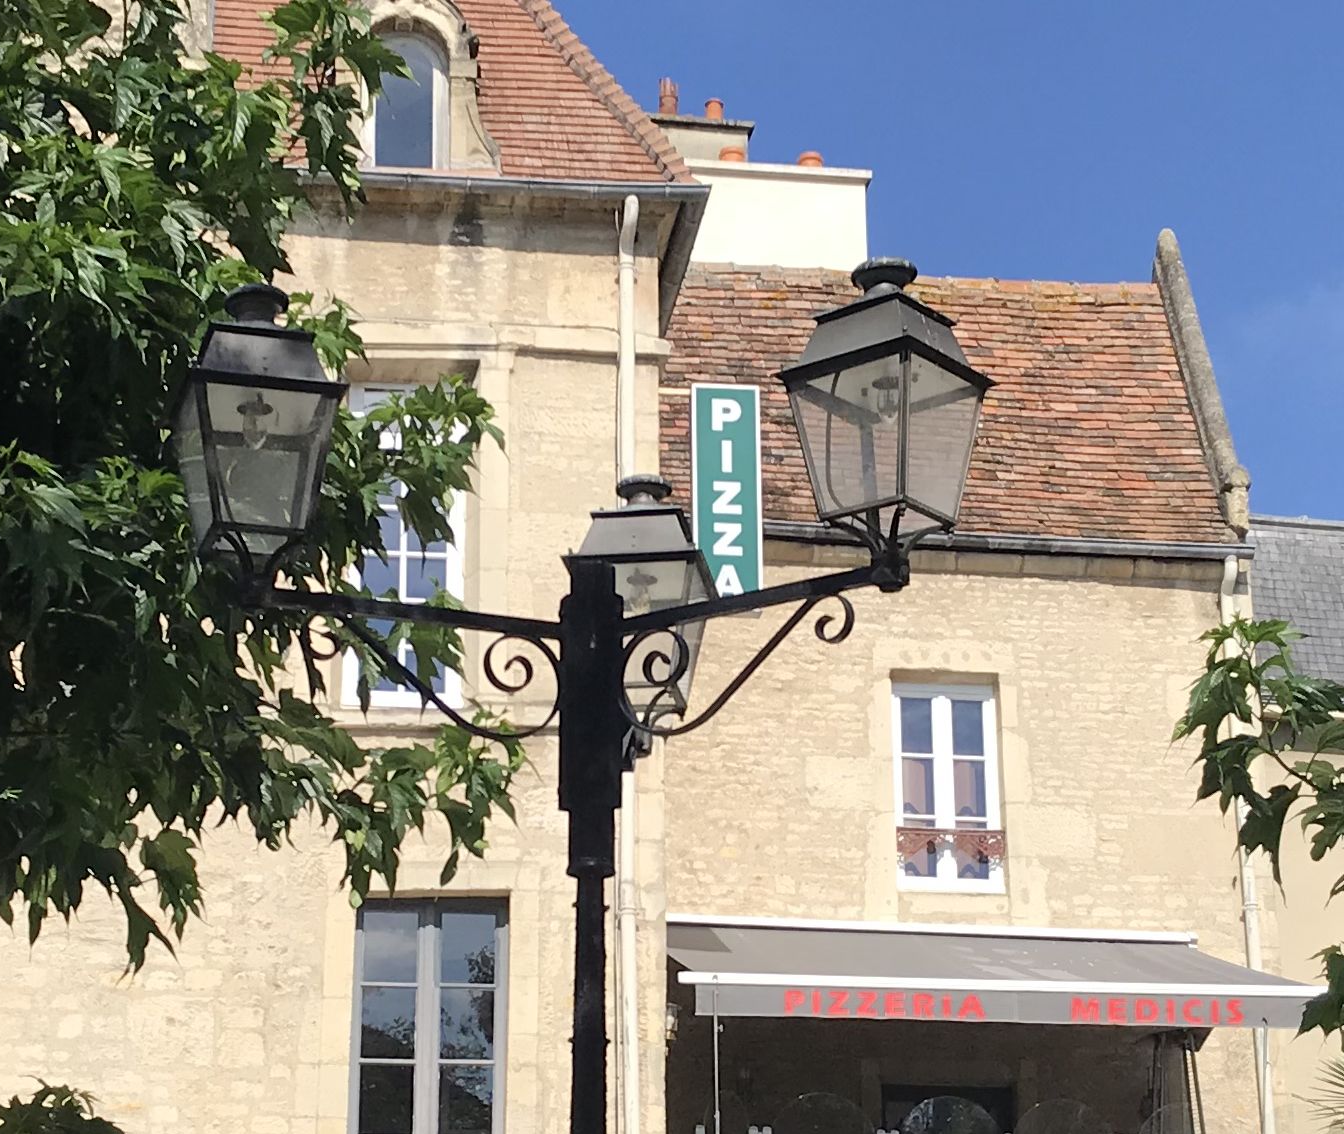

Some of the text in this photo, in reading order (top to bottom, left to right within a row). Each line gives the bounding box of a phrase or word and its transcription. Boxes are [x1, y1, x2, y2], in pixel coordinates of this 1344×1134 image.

[711, 398, 744, 598] PIZZA
[784, 989, 1245, 1025] PIZZERIA MEDICIS
